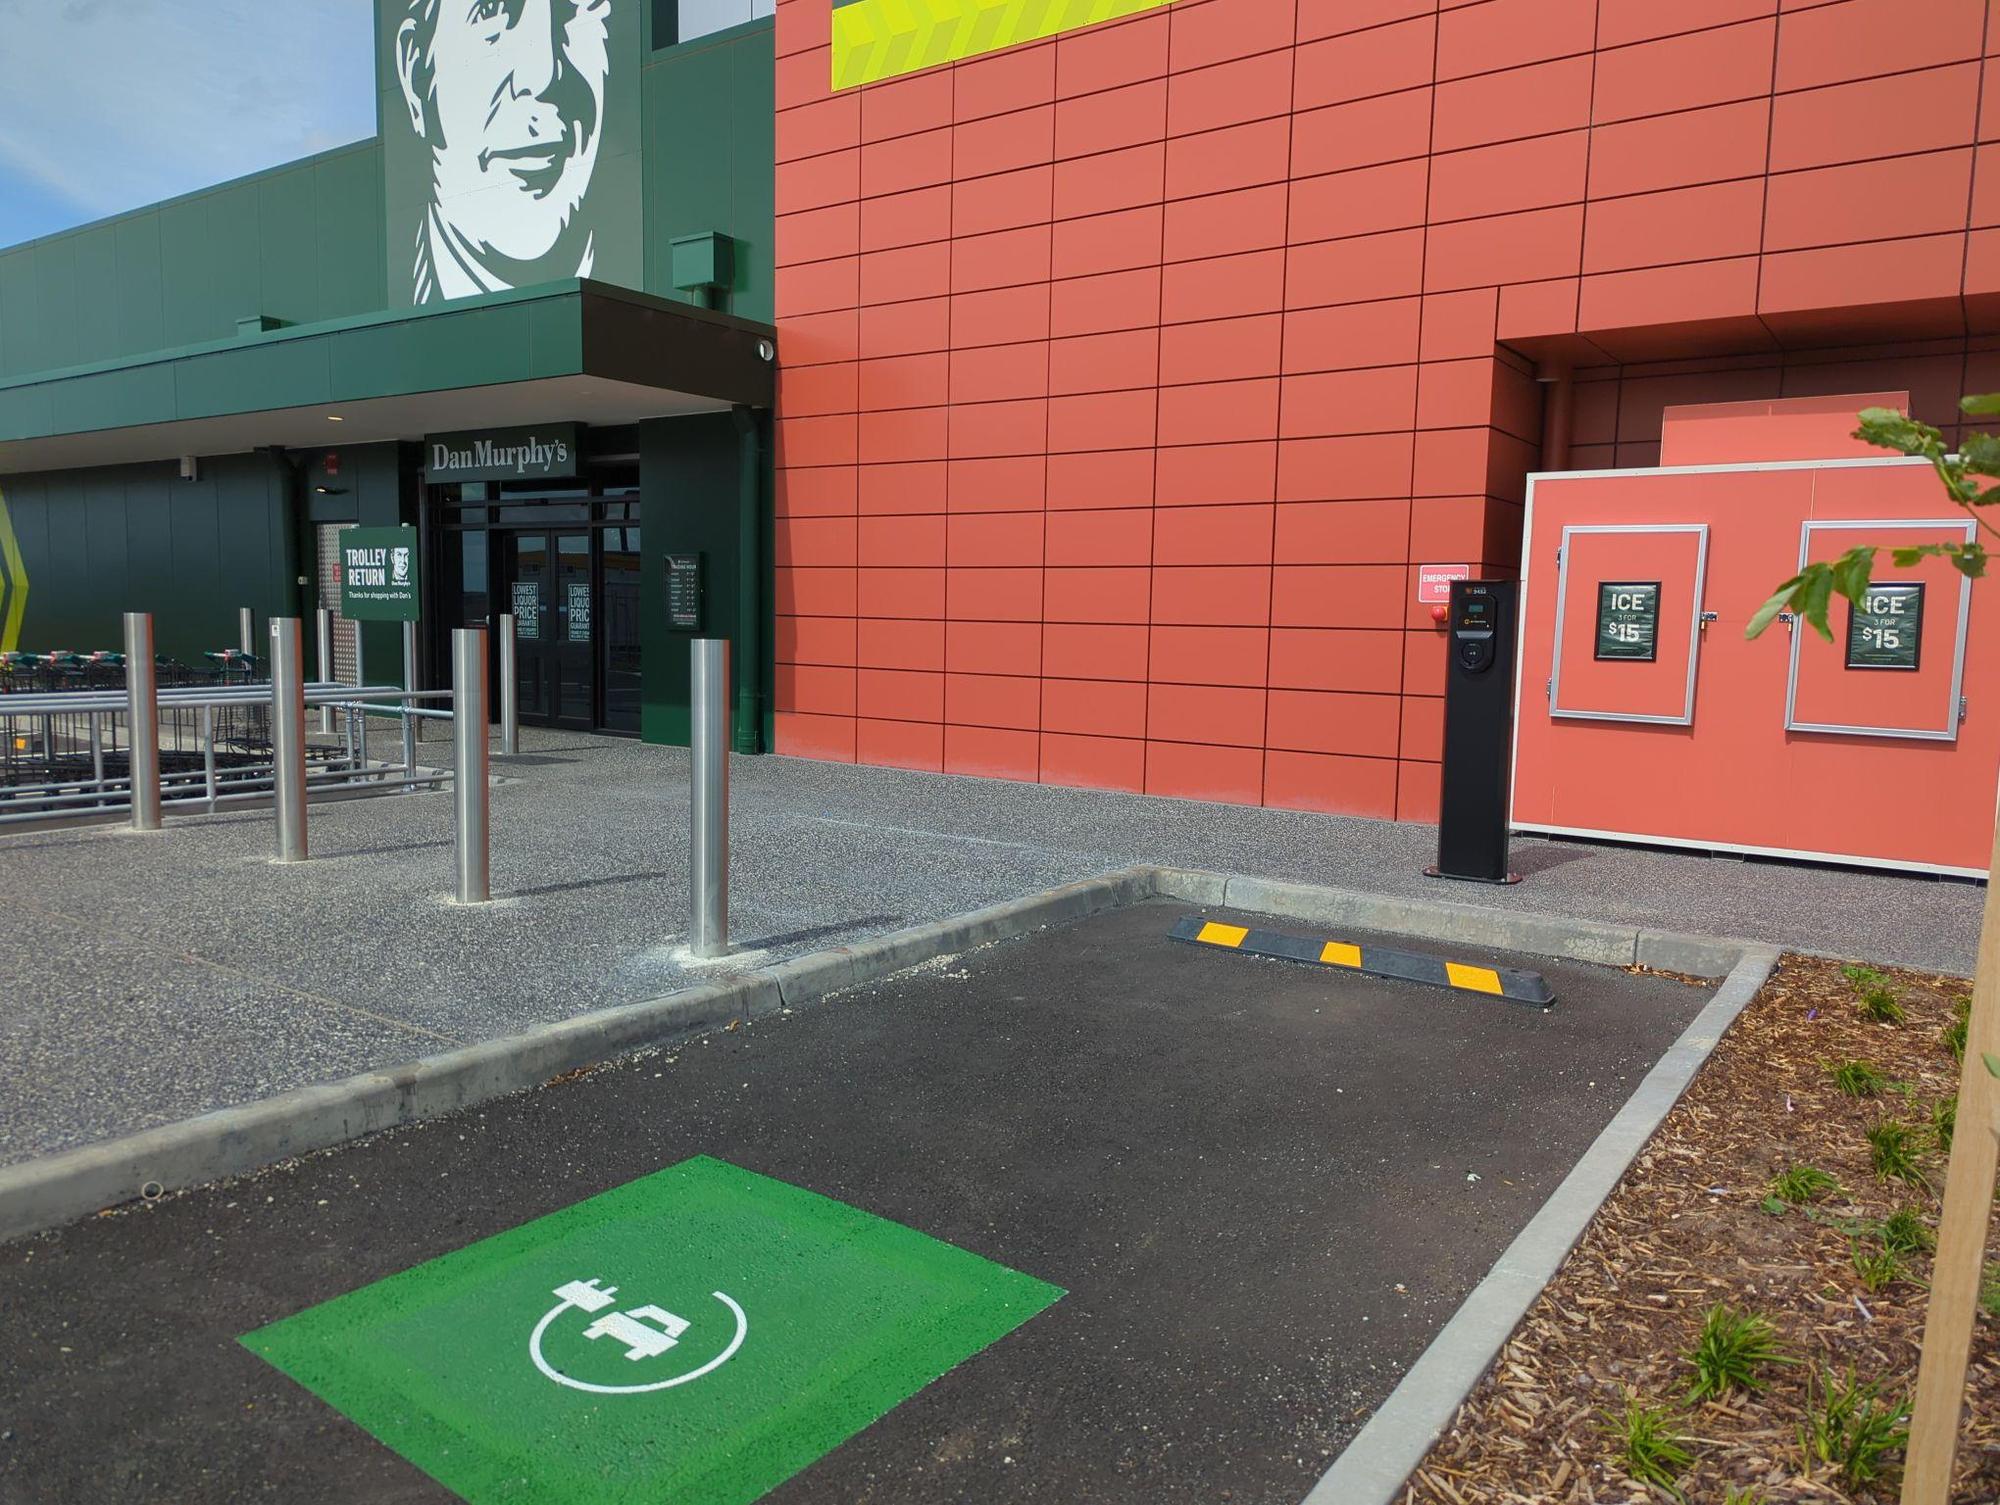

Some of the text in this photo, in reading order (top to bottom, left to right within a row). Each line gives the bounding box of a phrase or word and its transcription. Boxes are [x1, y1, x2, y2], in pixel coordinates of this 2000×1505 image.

[346, 548, 387, 566] TROLLEY
[348, 568, 386, 586] RETURN
[1423, 574, 1466, 583] EMERGENCY
[370, 592, 389, 600] shopping
[513, 585, 537, 595] LOWEST
[514, 595, 537, 606] LIQUOR
[1611, 593, 1645, 611] ICE
[1866, 595, 1907, 614] ICE
[514, 606, 537, 620] PRICE
[1608, 621, 1640, 642] $15
[1862, 626, 1900, 649] $15
